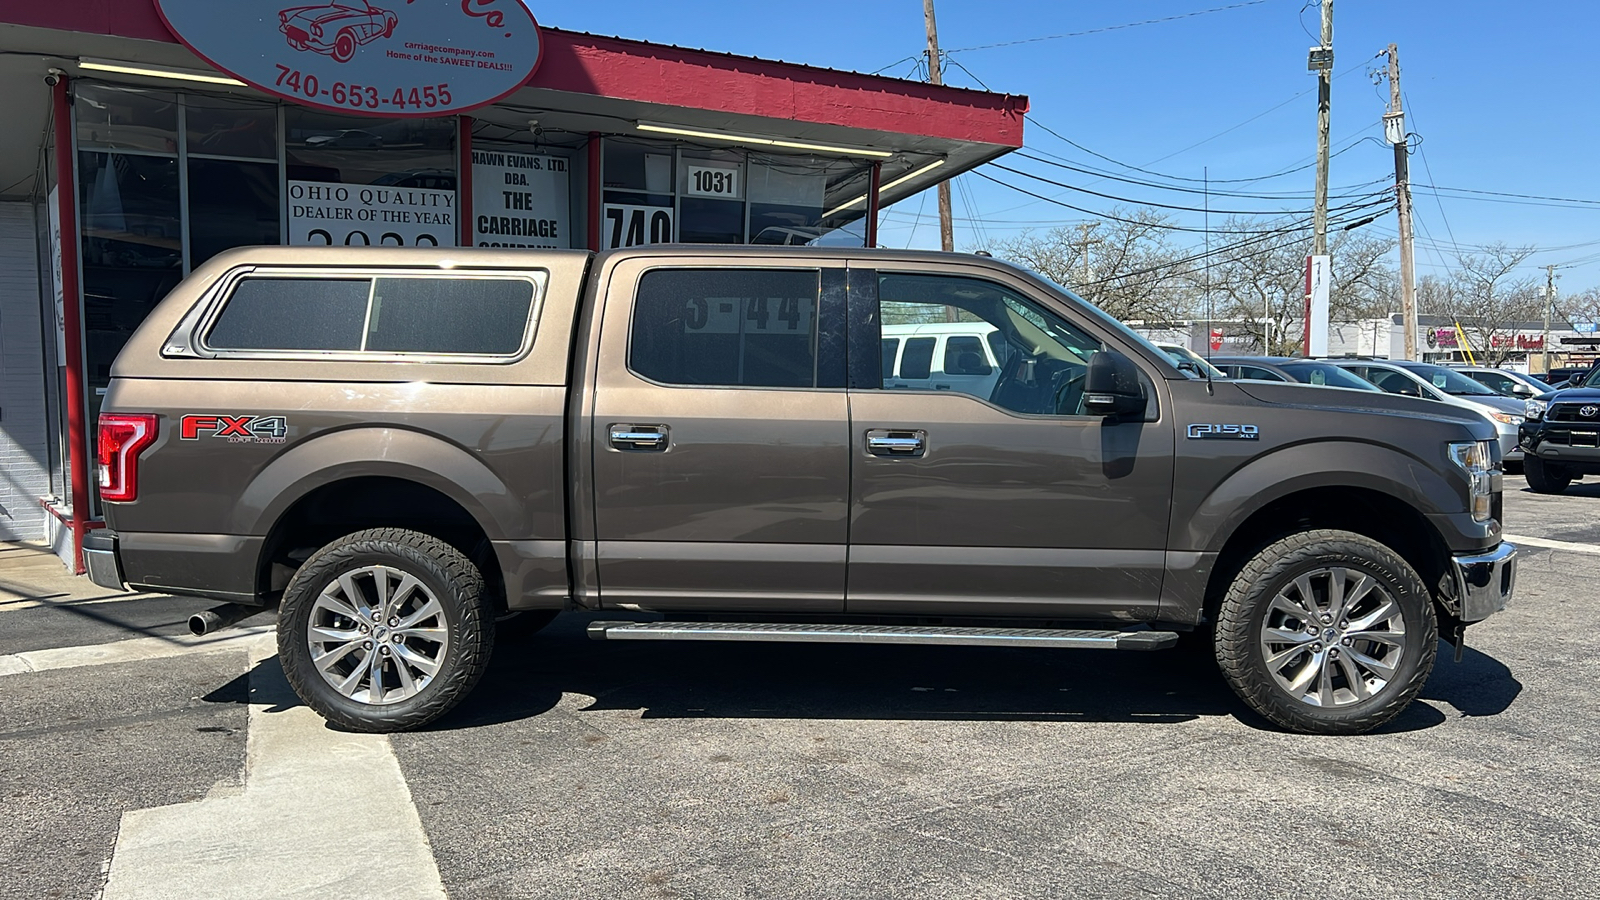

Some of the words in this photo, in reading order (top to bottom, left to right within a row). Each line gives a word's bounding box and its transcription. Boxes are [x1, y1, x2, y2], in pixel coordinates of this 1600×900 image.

[386, 50, 411, 60] Home
[424, 55, 438, 64] the
[439, 56, 475, 68] SAWEET
[477, 61, 513, 72] DEALS!!!
[404, 42, 495, 58] carriagecompany.com
[275, 63, 452, 110] 740-653-4455
[507, 155, 543, 171] EVANS.
[547, 158, 568, 173] LTD.
[504, 172, 530, 187] DBA.
[694, 170, 733, 194] 1031
[290, 185, 349, 202] OHIO
[360, 189, 454, 208] QUALITY
[503, 191, 533, 211] THE
[293, 205, 353, 220] DEALER
[357, 209, 377, 222] OF
[381, 210, 411, 223] THE
[414, 212, 452, 225] YEAR
[477, 215, 558, 238] CARRIAGE
[606, 208, 671, 249] 740
[180, 413, 288, 441] FX4
